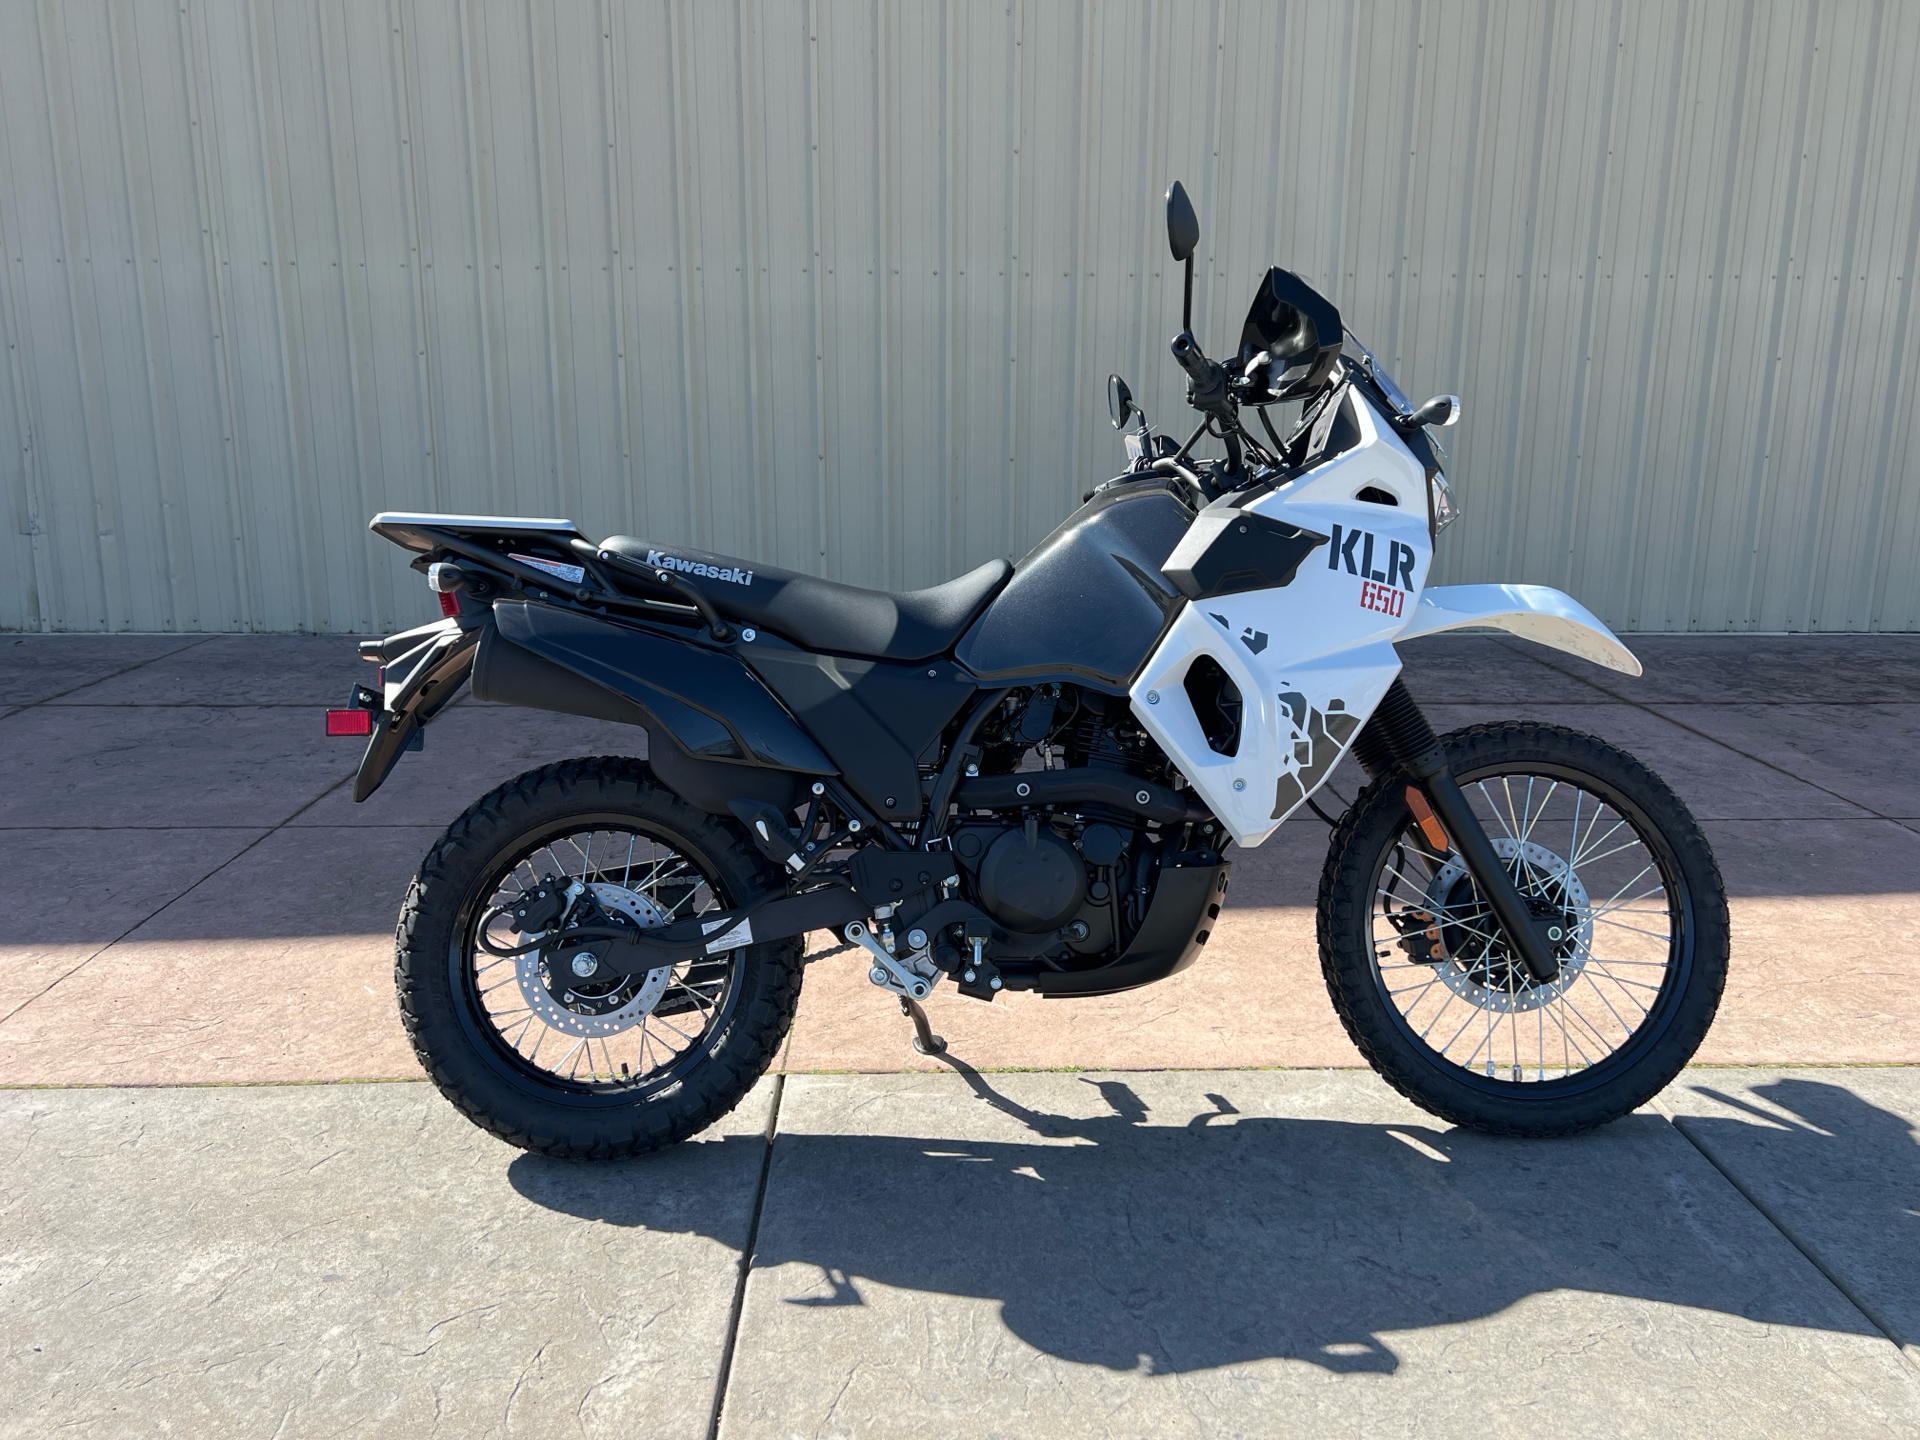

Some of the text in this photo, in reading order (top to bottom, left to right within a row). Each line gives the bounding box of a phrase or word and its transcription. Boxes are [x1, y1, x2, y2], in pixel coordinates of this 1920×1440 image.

[646, 549, 753, 586] Kawasaki
[1328, 523, 1416, 593] KLR
[1360, 580, 1405, 618] 650
